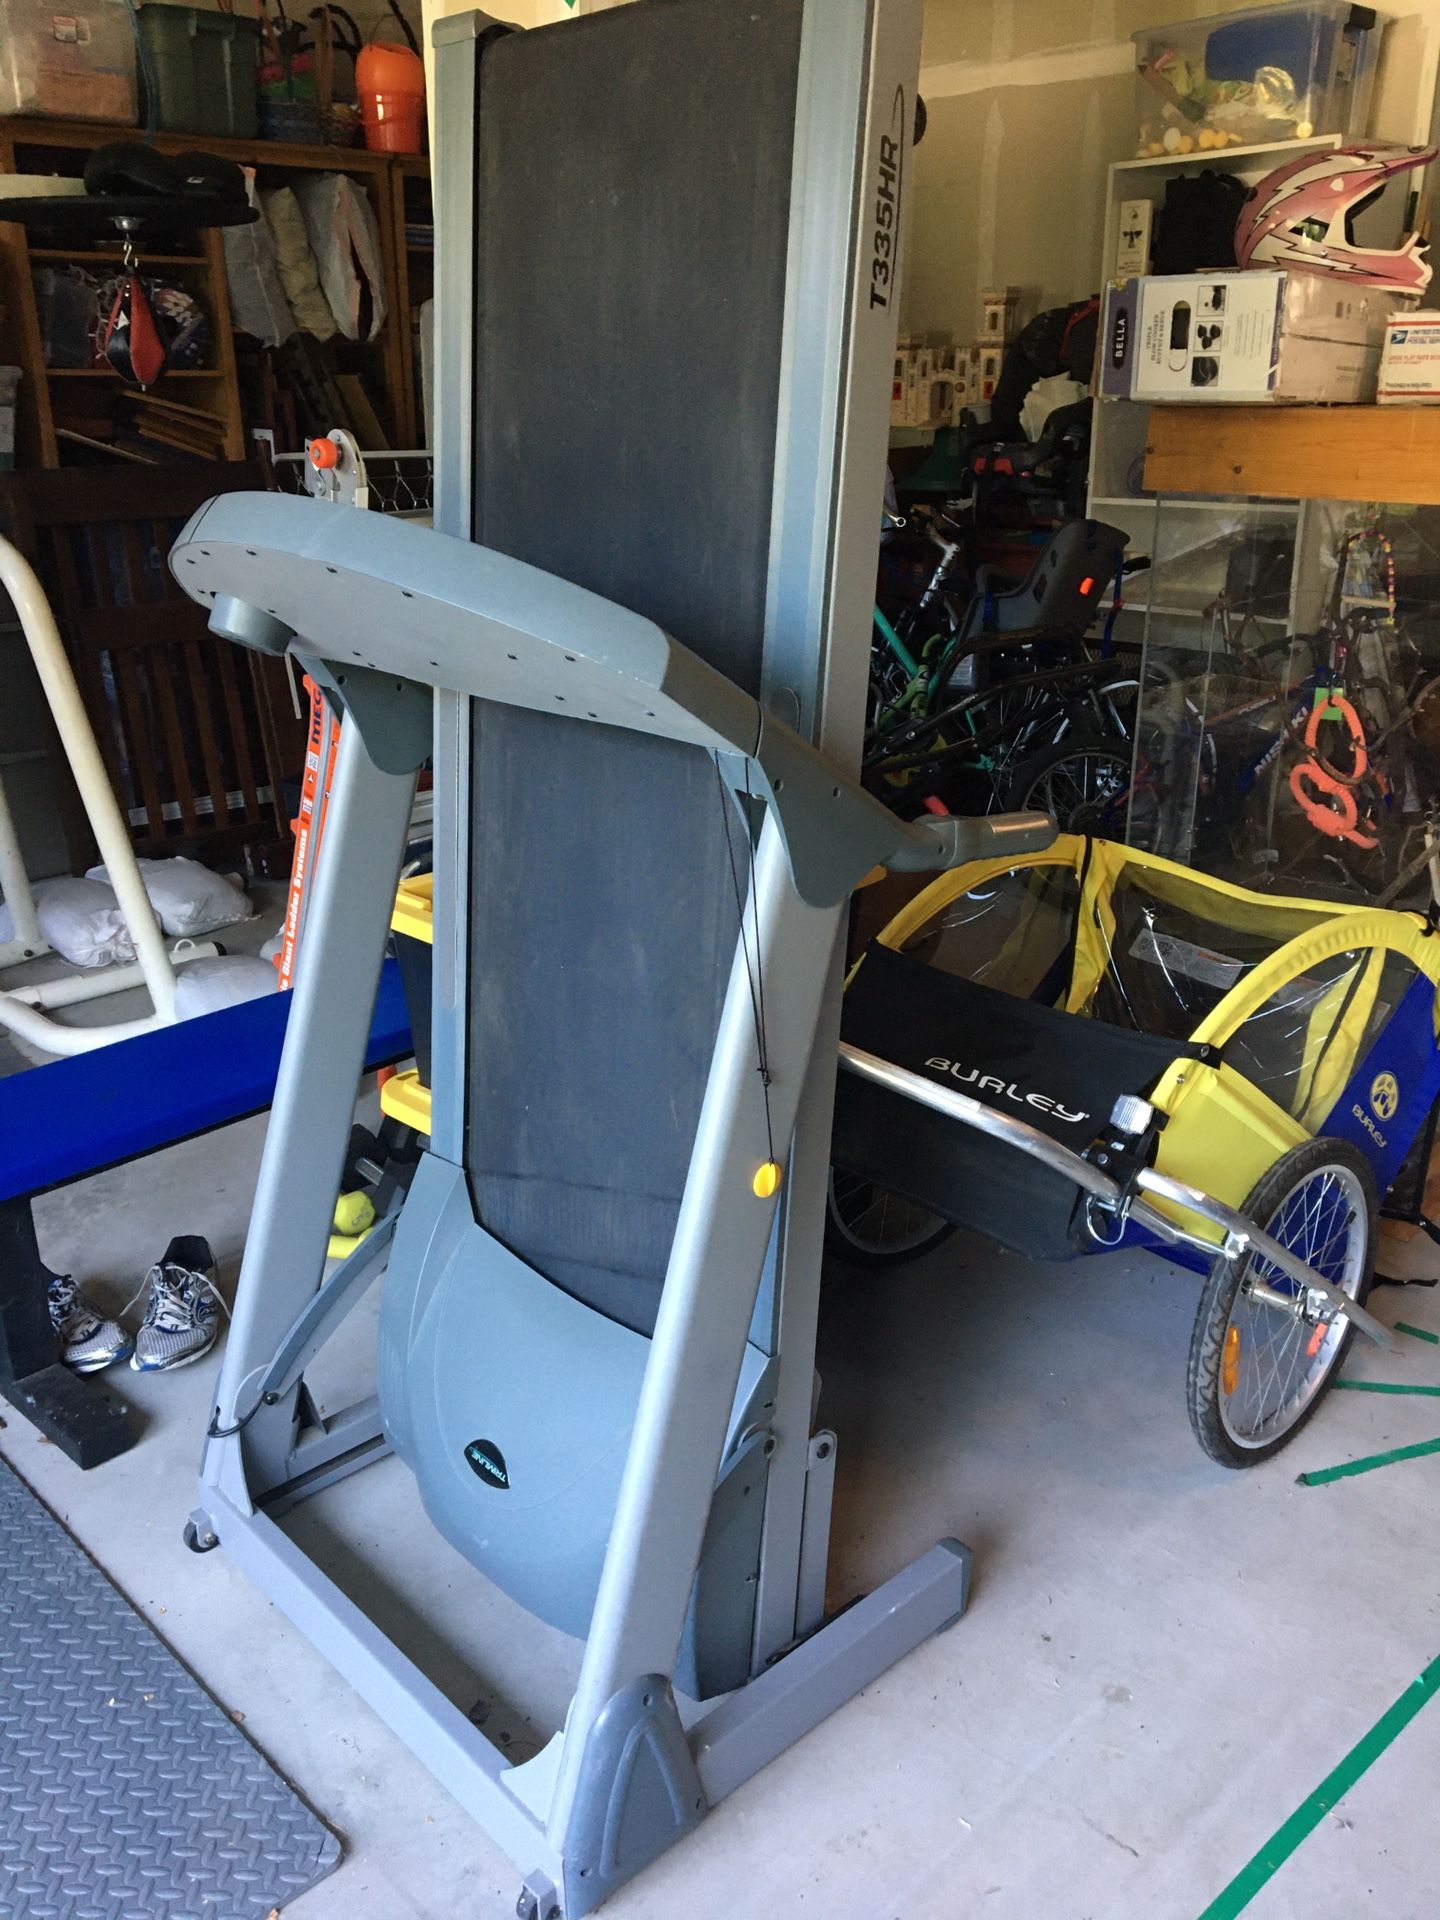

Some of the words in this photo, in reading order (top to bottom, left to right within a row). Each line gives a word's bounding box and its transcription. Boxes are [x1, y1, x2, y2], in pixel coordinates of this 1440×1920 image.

[870, 134, 899, 311] T335HR
[1115, 318, 1126, 358] BELLA
[293, 829, 308, 889] Systems
[287, 892, 300, 939] Ladder
[282, 941, 294, 976] Giant
[924, 1057, 1087, 1122] BURLEY
[1352, 1104, 1387, 1147] BURLEY
